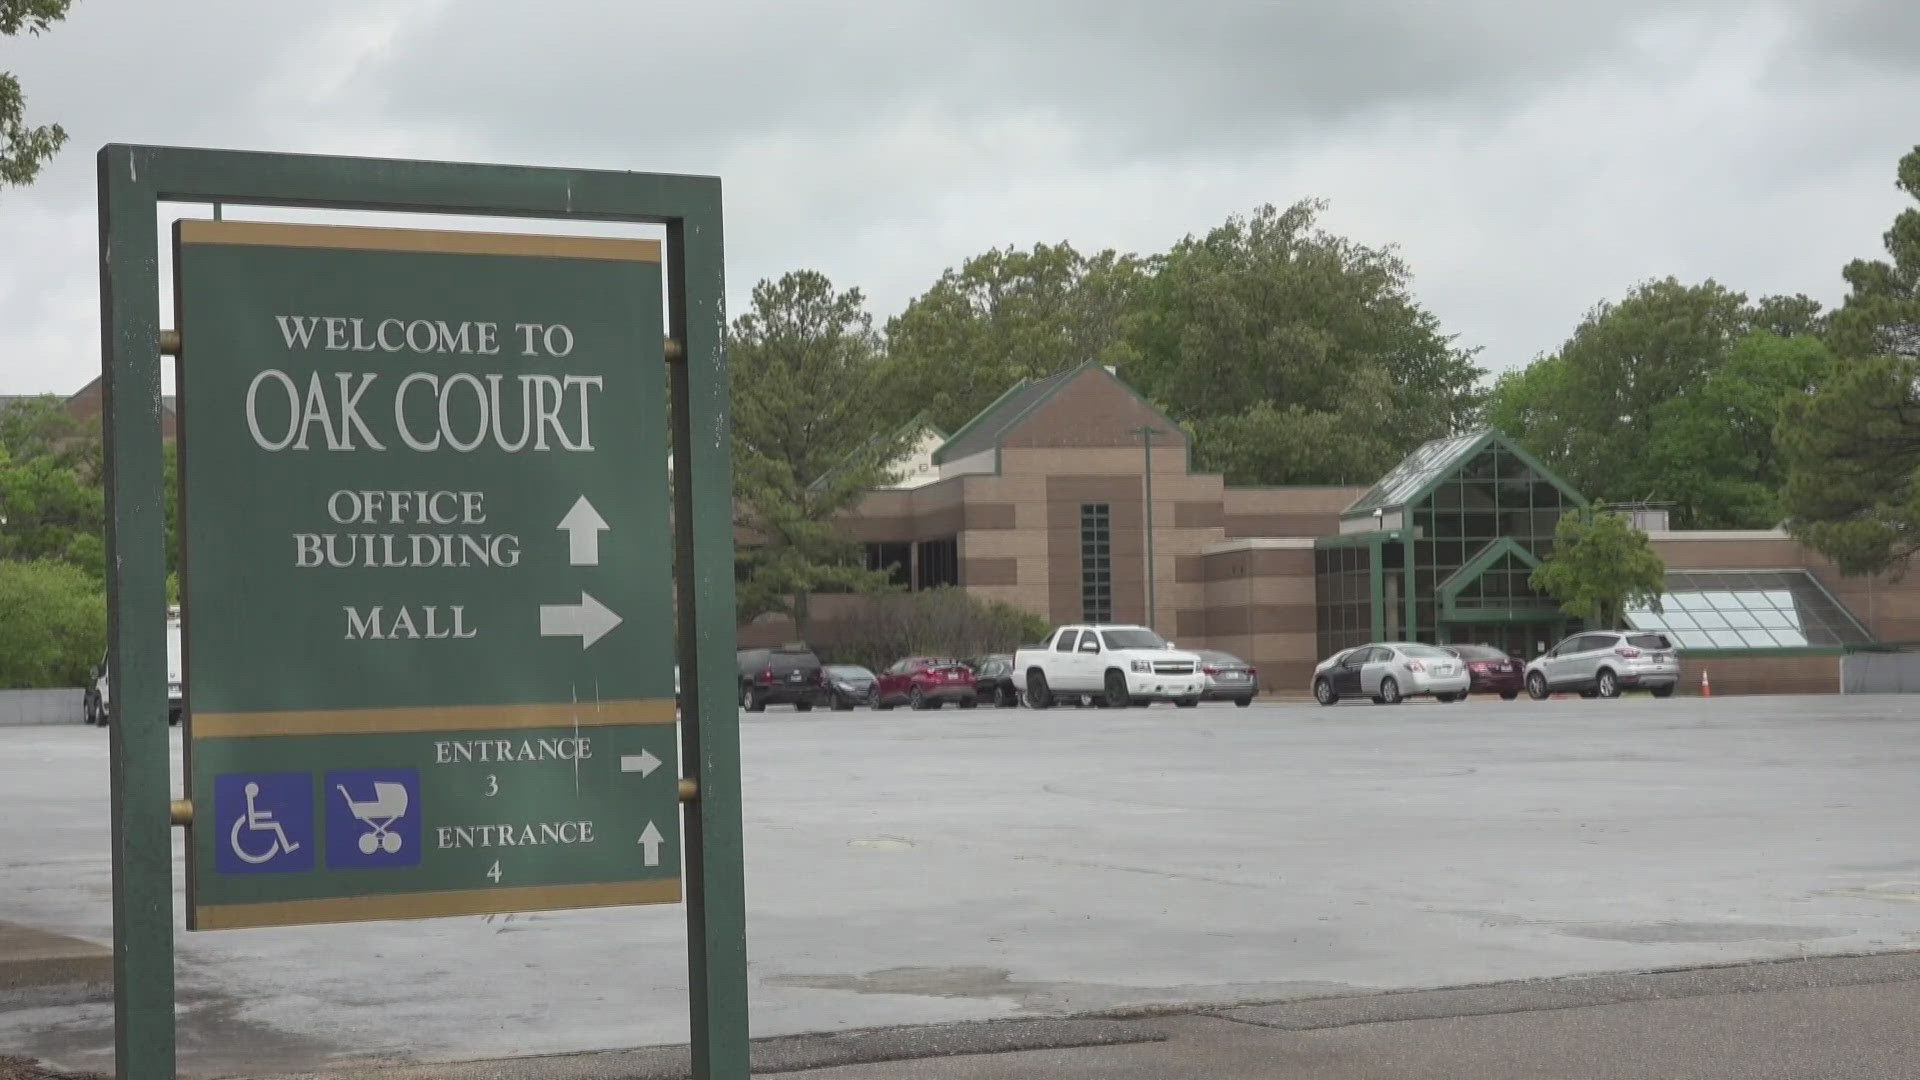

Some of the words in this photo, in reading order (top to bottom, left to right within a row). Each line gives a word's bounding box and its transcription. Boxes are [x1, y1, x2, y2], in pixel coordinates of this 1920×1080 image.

[275, 315, 500, 355] WELCOME
[515, 323, 574, 357] TO
[245, 368, 387, 452] OAK
[394, 371, 603, 453] COURT
[327, 489, 487, 525] OFFICE
[292, 533, 521, 568] BUILDING
[343, 605, 477, 640] MALL
[434, 736, 593, 764] ENTRANCE
[484, 773, 499, 797] 3
[436, 820, 595, 849] ENTRANCE
[486, 859, 503, 884] 4
